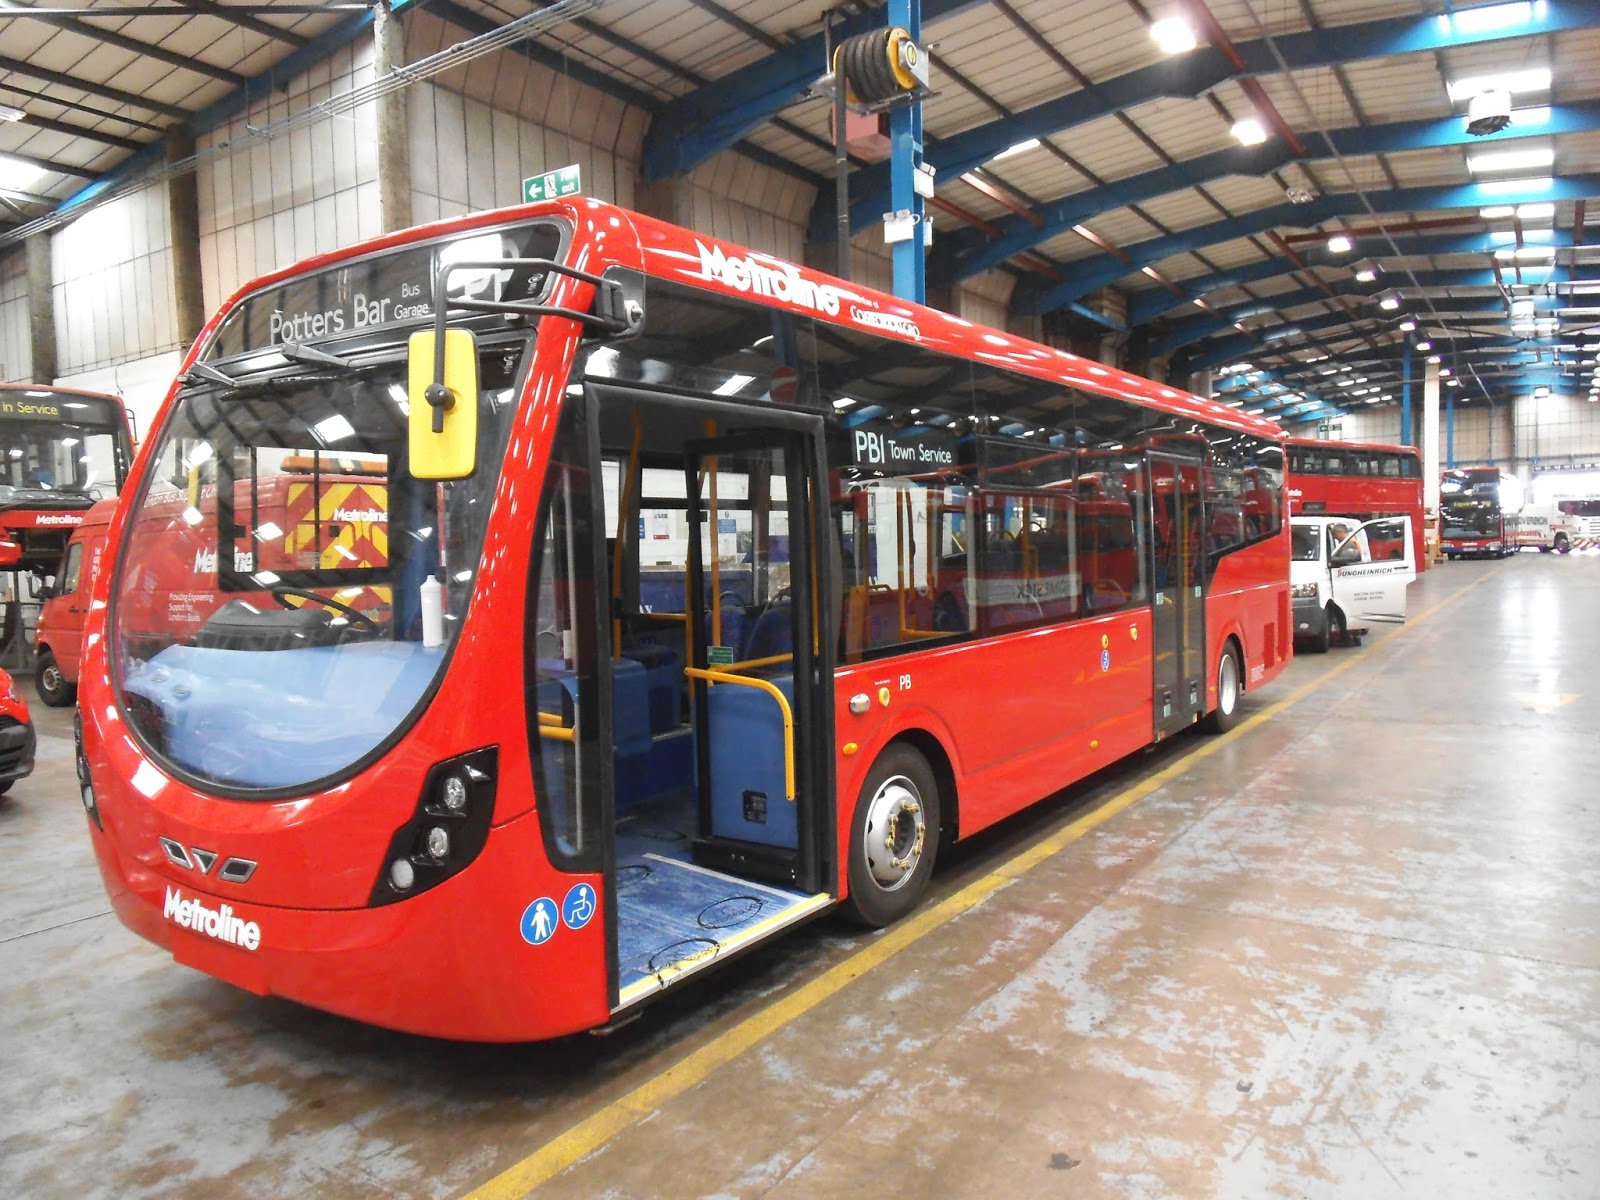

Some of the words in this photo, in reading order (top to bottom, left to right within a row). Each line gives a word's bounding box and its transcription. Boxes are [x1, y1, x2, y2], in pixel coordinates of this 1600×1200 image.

[561, 182, 575, 193] exit
[694, 238, 841, 317] Metroline
[401, 283, 421, 298] Bus
[394, 302, 430, 320] Garage
[269, 308, 345, 346] Potters
[353, 293, 391, 329] Bar
[2, 402, 14, 413] in
[17, 401, 59, 416] Service
[887, 439, 916, 461] Town
[917, 442, 953, 465] Service
[35, 514, 84, 525] Metroline
[332, 507, 388, 522] Metroline
[193, 545, 253, 573] Metine
[187, 592, 214, 604] Engineering
[168, 602, 186, 612] Support
[899, 673, 912, 691] PB
[163, 884, 261, 951] Metroline
